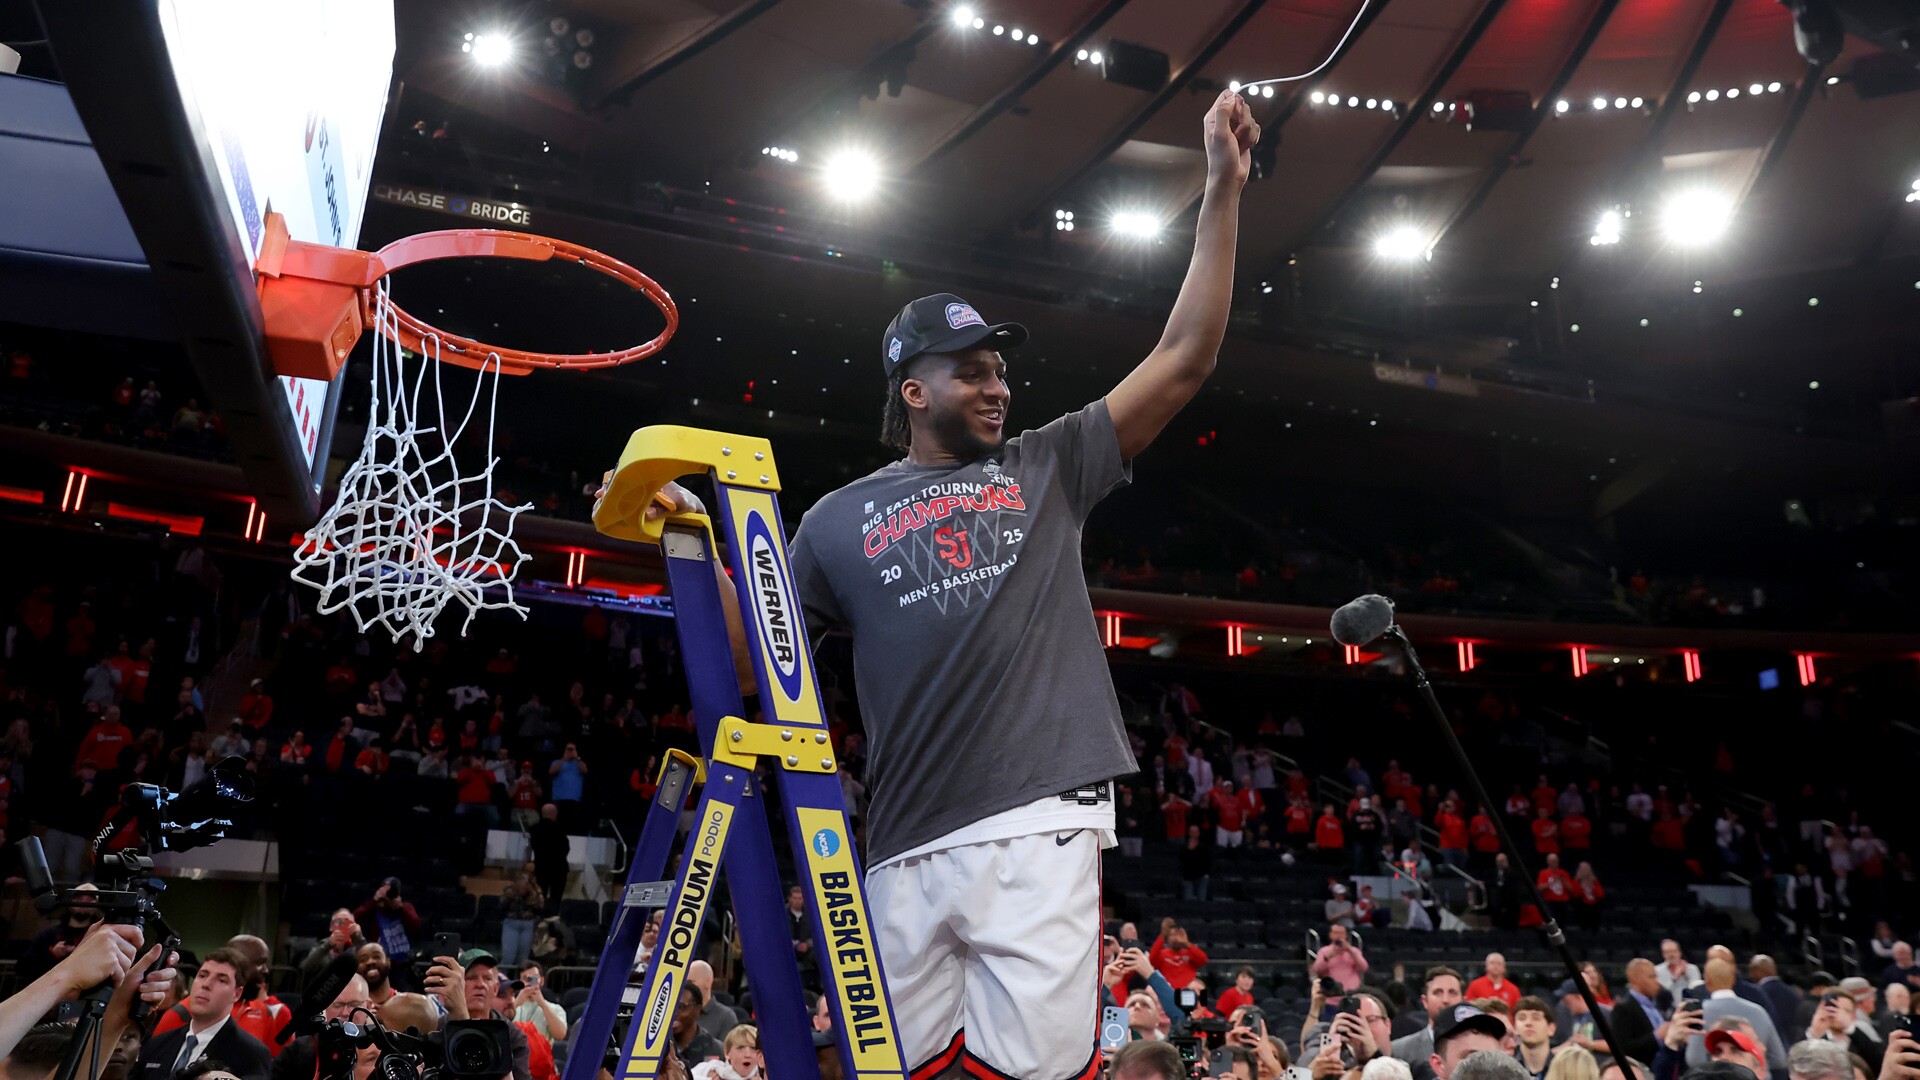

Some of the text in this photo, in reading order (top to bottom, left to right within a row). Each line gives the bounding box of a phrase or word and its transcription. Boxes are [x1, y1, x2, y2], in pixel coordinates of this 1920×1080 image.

[374, 184, 532, 226] CHASE BRIDGE
[862, 512, 883, 535] BIG
[921, 473, 1015, 499] TOURNAENT
[864, 483, 1026, 559] CHAMPIONS
[933, 526, 973, 569] SJ
[1003, 528, 1024, 545] 25
[880, 564, 902, 586] 20
[899, 582, 940, 608] MEN'S
[754, 548, 793, 663] WERNER
[93, 822, 114, 855] ONIN
[817, 832, 829, 858] NCAA
[663, 810, 724, 969] PODIUM PODIO
[819, 871, 887, 1054] BASKETBALL
[649, 986, 669, 1035] WERNER
